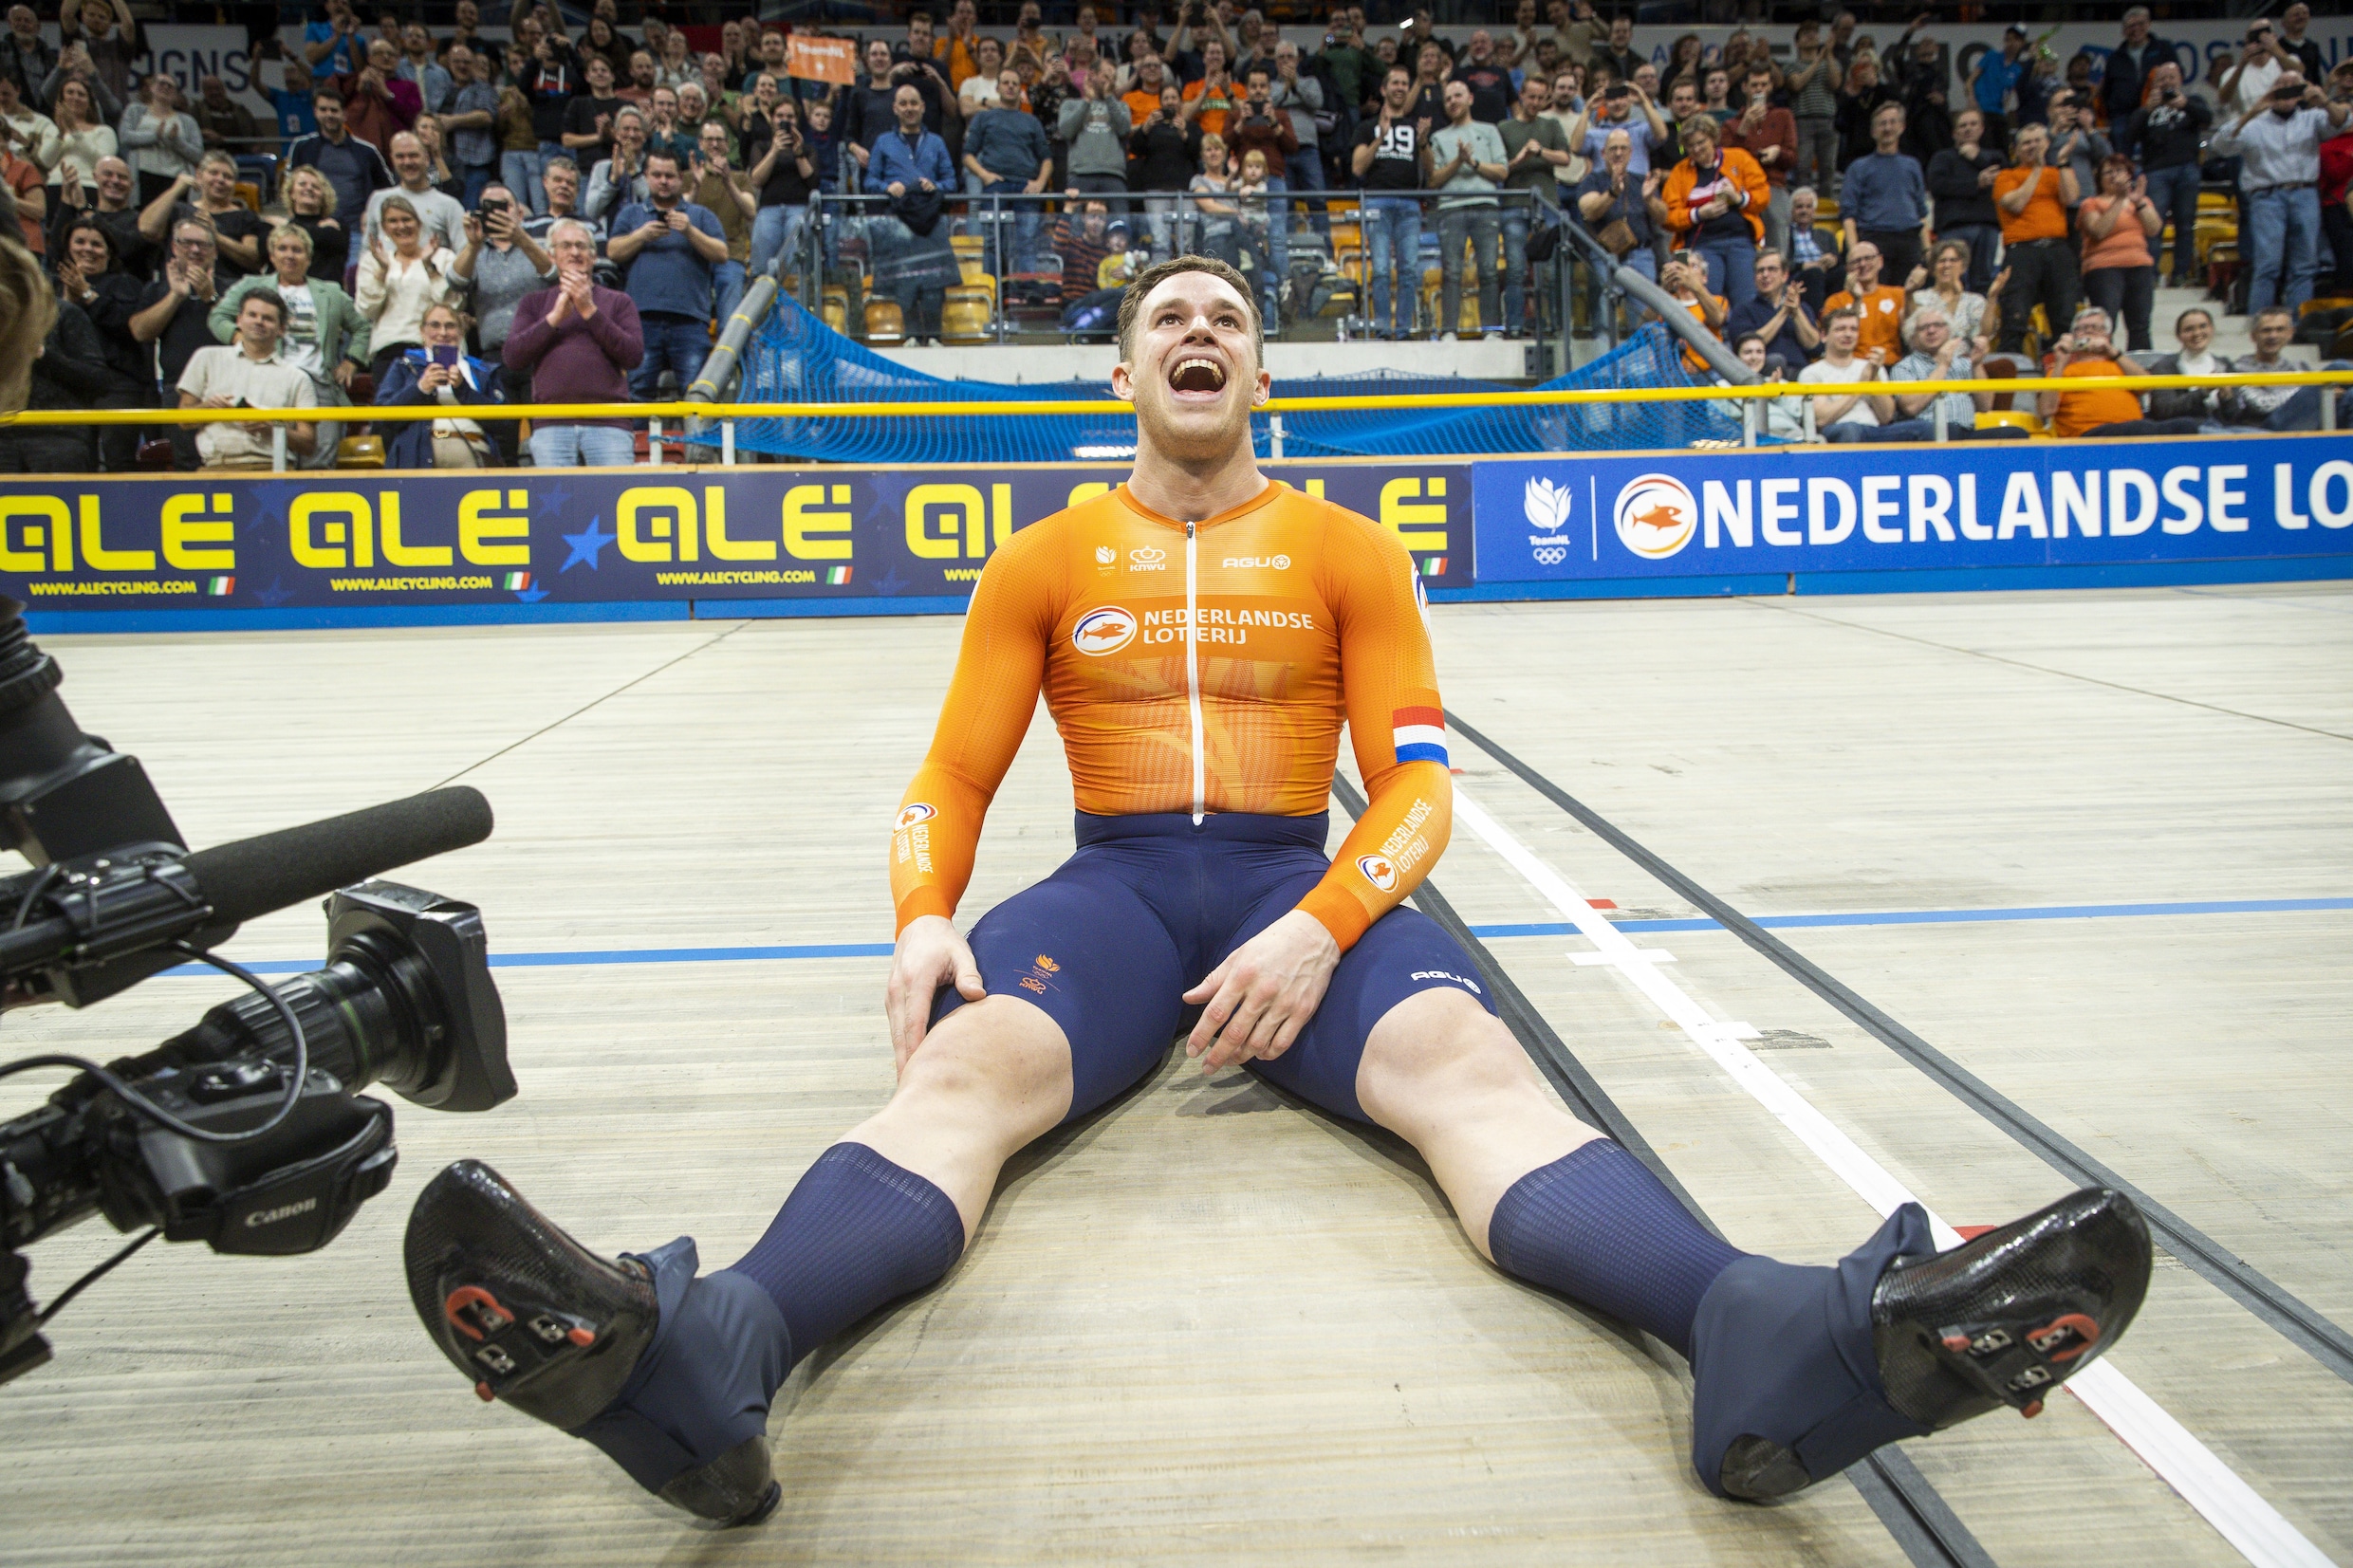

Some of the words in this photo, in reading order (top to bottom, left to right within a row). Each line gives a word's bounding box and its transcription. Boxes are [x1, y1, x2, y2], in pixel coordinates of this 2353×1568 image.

[1703, 464, 2249, 548] NEDERLANDSE
[1529, 534, 1570, 546] TeamNL
[1222, 556, 1271, 568] AGU
[330, 576, 493, 591] WWW.ALECYCLING.COM
[656, 570, 816, 585] WWW.ALECYCLING.COM
[29, 581, 197, 596] WWW.ALECYCLING.COM
[1144, 608, 1314, 630] NEDERLANDSE
[1143, 626, 1247, 645] LOTERIJ
[1379, 798, 1433, 858] NEDERLANDSE
[1395, 834, 1430, 874] LOTERIJ
[1410, 970, 1463, 983] AGU
[245, 1197, 317, 1227] Canon
